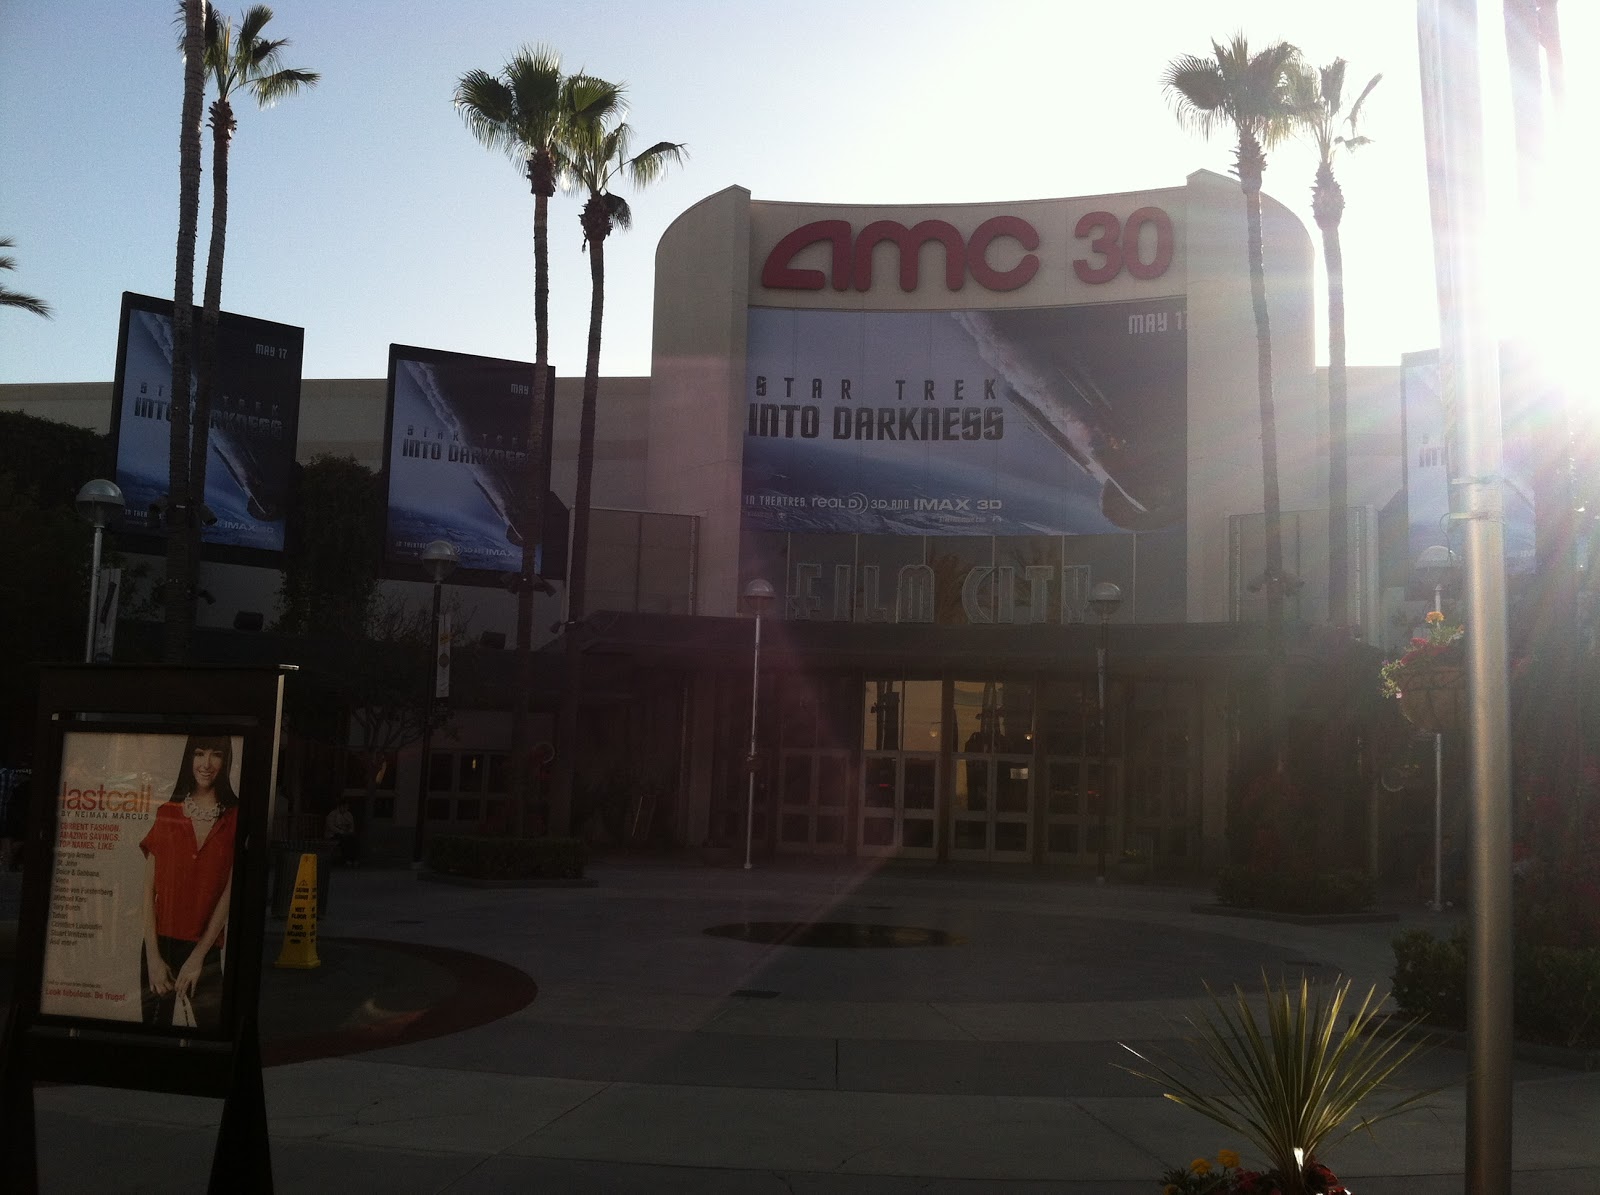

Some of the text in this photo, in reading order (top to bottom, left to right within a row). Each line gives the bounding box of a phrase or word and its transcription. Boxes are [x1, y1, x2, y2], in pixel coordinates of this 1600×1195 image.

[1073, 206, 1174, 284] 30
[1128, 312, 1168, 334] MAY
[255, 343, 288, 359] MAY 17
[510, 383, 529, 395] MAY
[755, 376, 997, 401] STAR TREK
[748, 403, 1004, 441] INTO DARKNESS
[402, 439, 441, 460] INTO
[913, 499, 970, 510] IMAX
[977, 499, 1003, 510] 3D
[790, 563, 1091, 624] FILM CITY
[75, 811, 108, 819] NEIMAN
[112, 812, 149, 821] MARCUS
